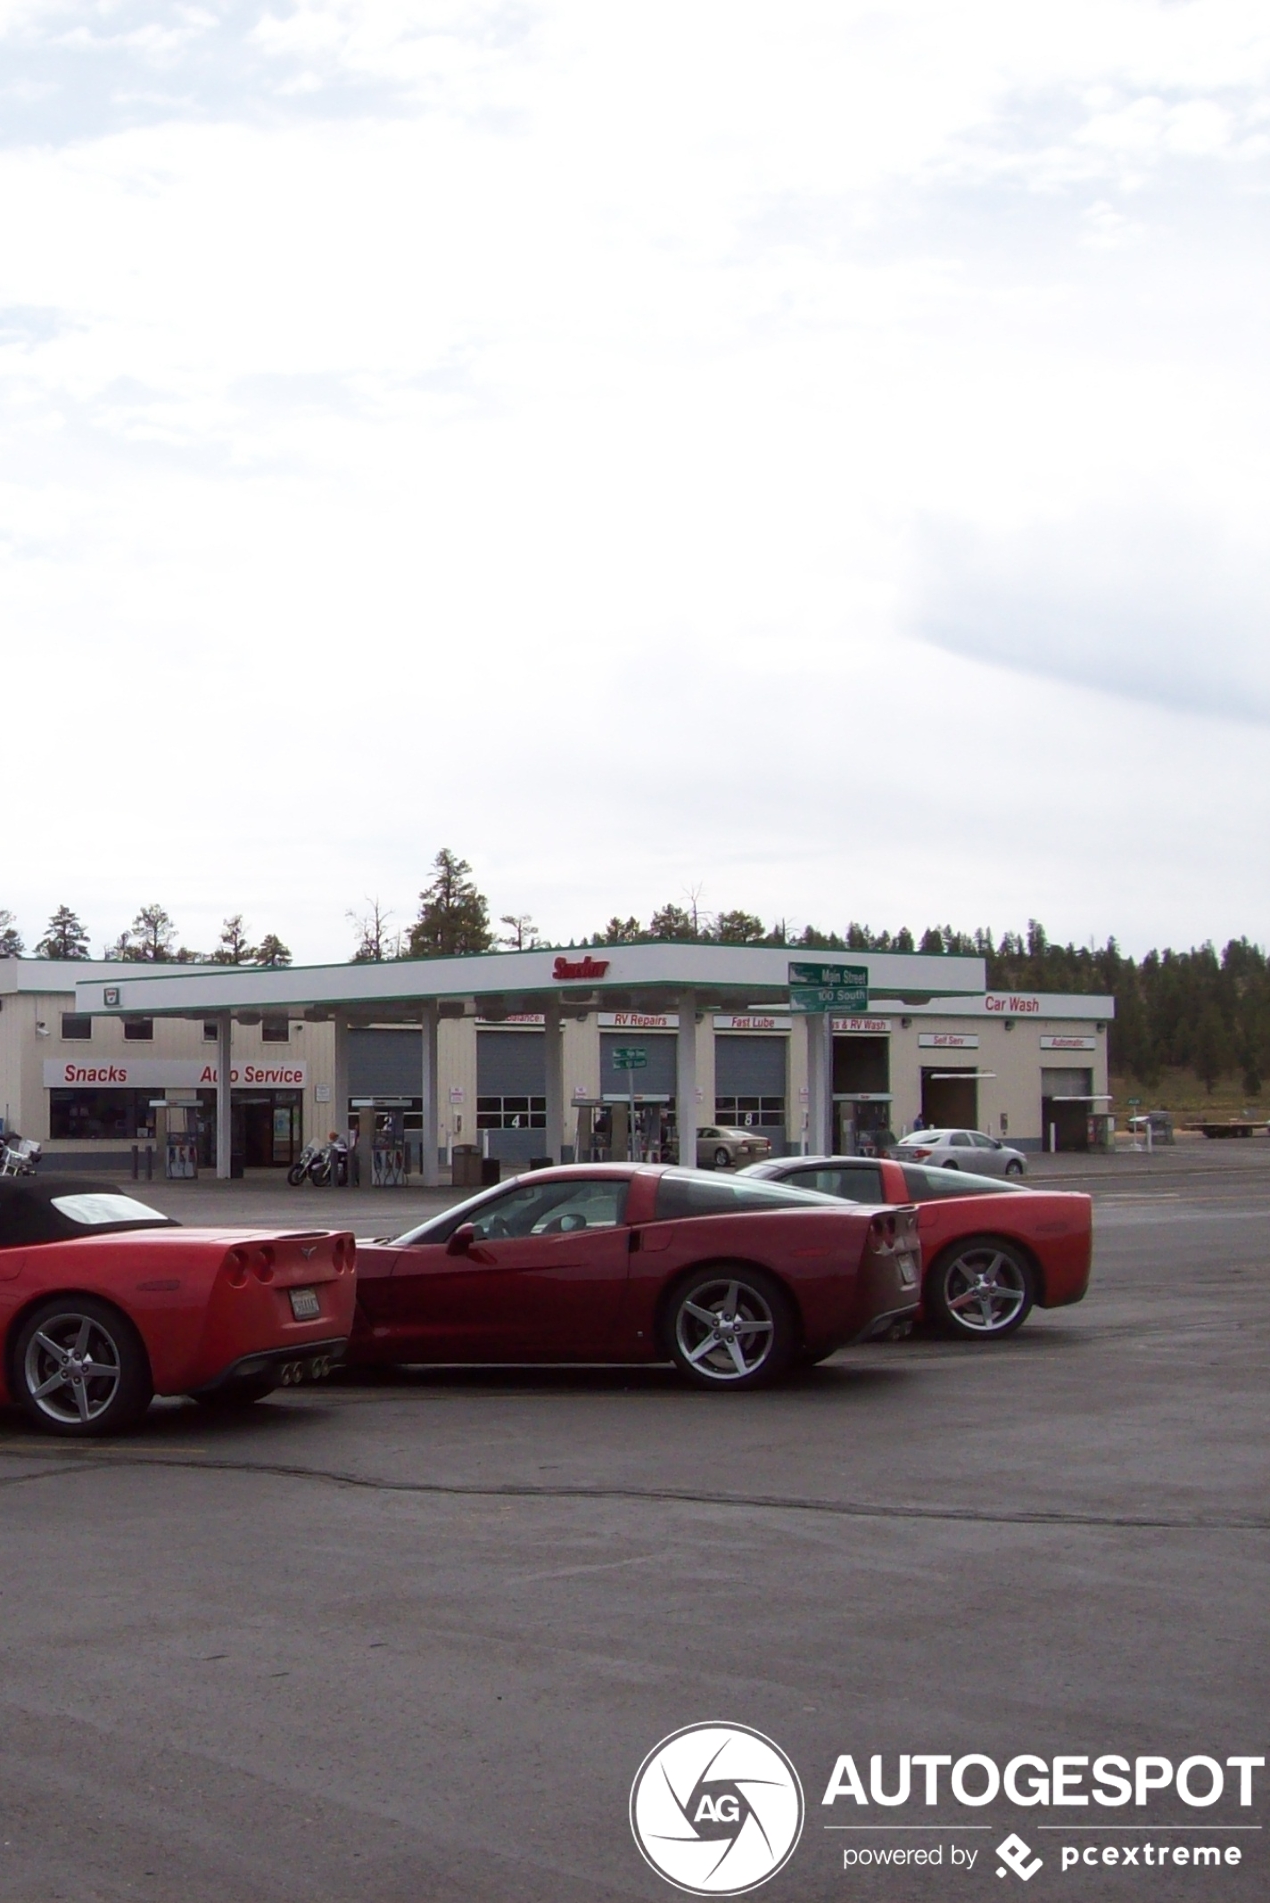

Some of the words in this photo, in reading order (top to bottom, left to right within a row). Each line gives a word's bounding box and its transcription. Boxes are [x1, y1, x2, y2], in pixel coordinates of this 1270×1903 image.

[822, 968, 841, 984] Main
[843, 969, 866, 985] Street
[818, 990, 834, 1001] 100
[837, 988, 866, 1001] South
[985, 996, 1006, 1011] Car
[1009, 996, 1040, 1012] Wash
[615, 1014, 629, 1025] RV
[631, 1014, 667, 1027] Repairs
[732, 1017, 750, 1027] Fast
[753, 1017, 775, 1028] Lube
[850, 1019, 863, 1029] RV
[864, 1020, 886, 1030] Wash
[64, 1064, 127, 1082] Snacks
[200, 1066, 239, 1083] Auo
[244, 1066, 303, 1083] Service
[511, 1115, 520, 1128] 4
[744, 1113, 753, 1126] 8
